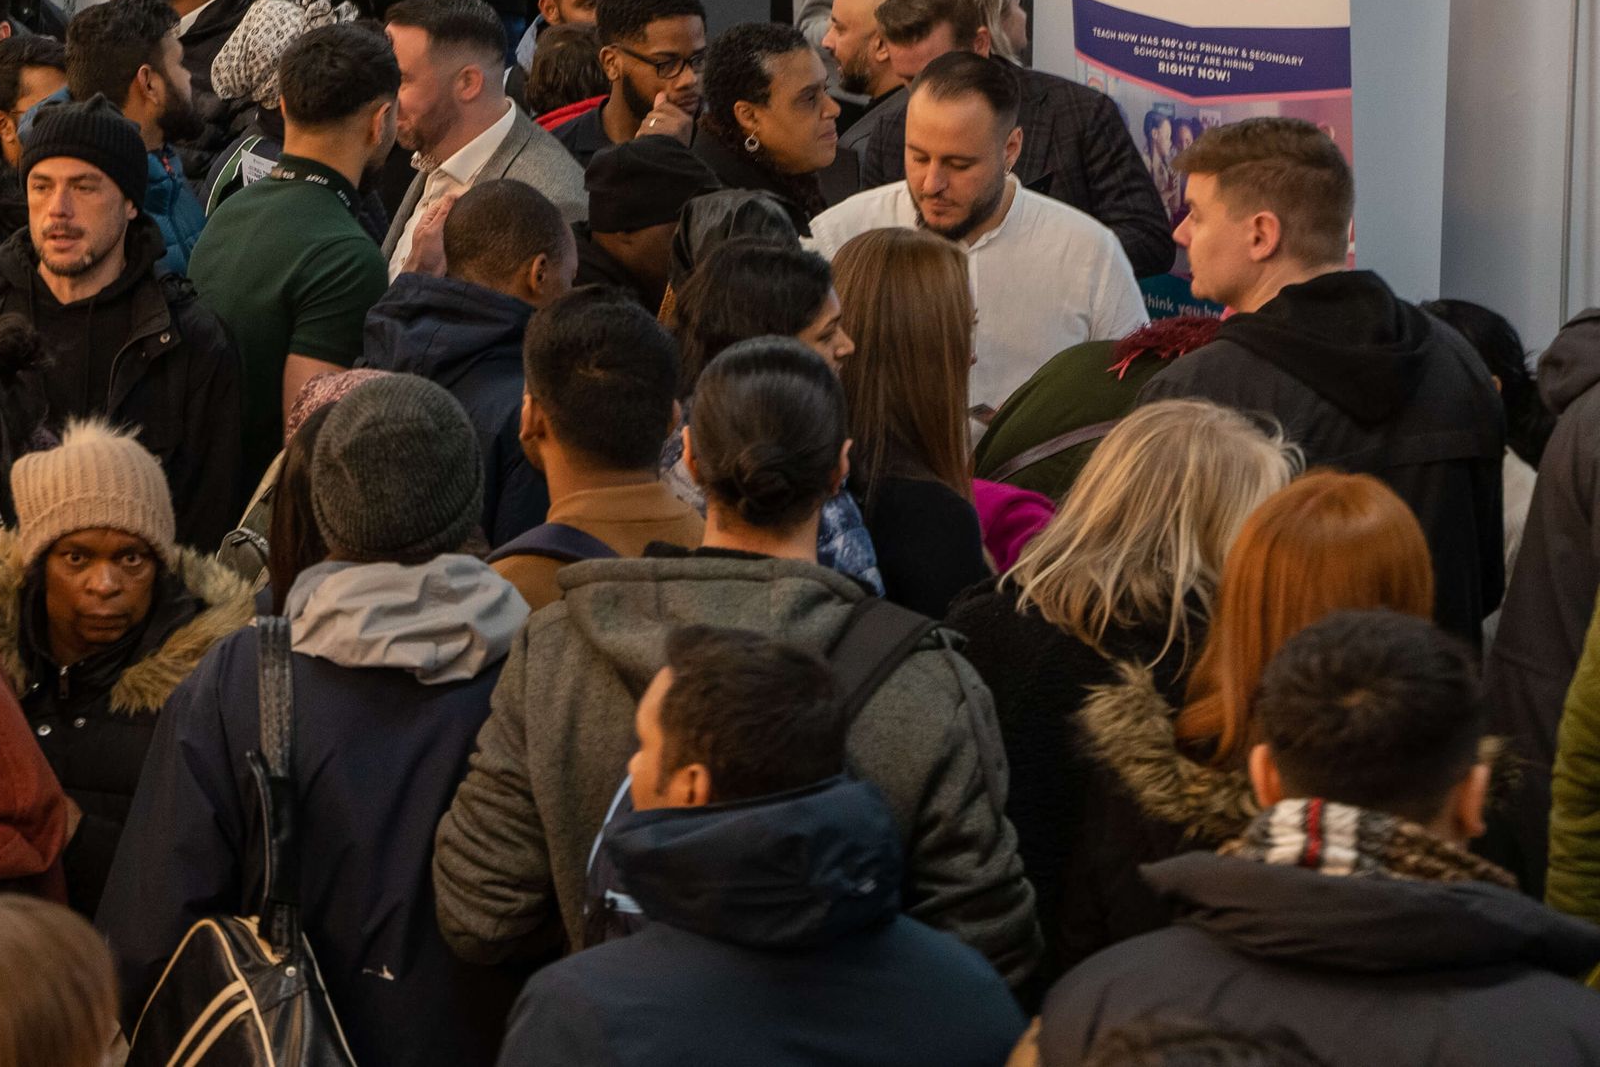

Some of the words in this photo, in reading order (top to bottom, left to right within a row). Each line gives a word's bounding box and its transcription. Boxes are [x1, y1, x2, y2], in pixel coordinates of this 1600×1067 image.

[1092, 26, 1117, 41] TEACH
[1118, 31, 1138, 44] NOW
[1140, 35, 1159, 47] HAS
[1186, 41, 1198, 51] OF
[1199, 43, 1239, 58] PRIMARY
[1249, 49, 1304, 67] SECONDARY
[1133, 45, 1176, 61] SCHOOLS
[1178, 50, 1200, 63] THAT
[1203, 55, 1221, 67] ARE
[1223, 58, 1255, 72] HIRING
[1158, 61, 1194, 78] RIGHT
[1198, 65, 1231, 82] NOW!
[1178, 304, 1200, 318] you
